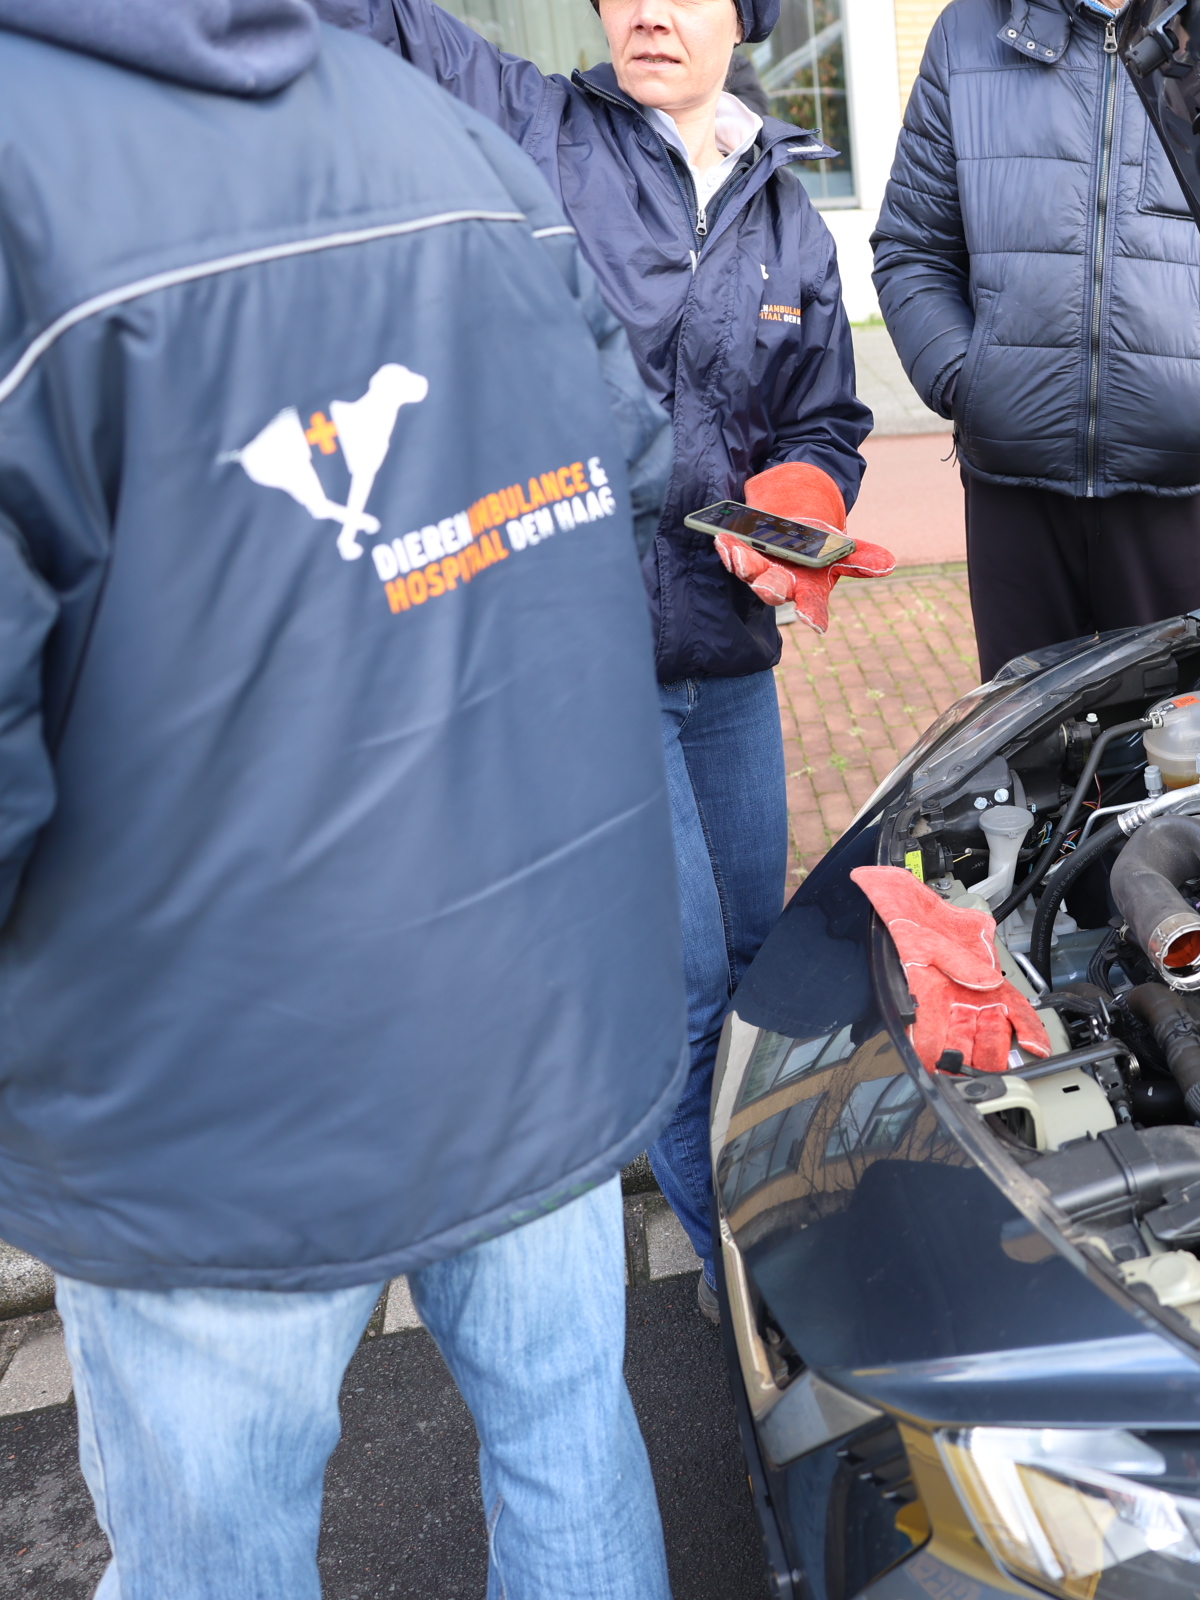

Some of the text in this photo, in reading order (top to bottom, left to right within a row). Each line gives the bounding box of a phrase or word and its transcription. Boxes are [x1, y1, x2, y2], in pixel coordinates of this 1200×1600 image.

[761, 304, 802, 316] NAMBULAN
[587, 456, 609, 487] &
[505, 507, 555, 552] DEN
[553, 485, 616, 533] HAAG
